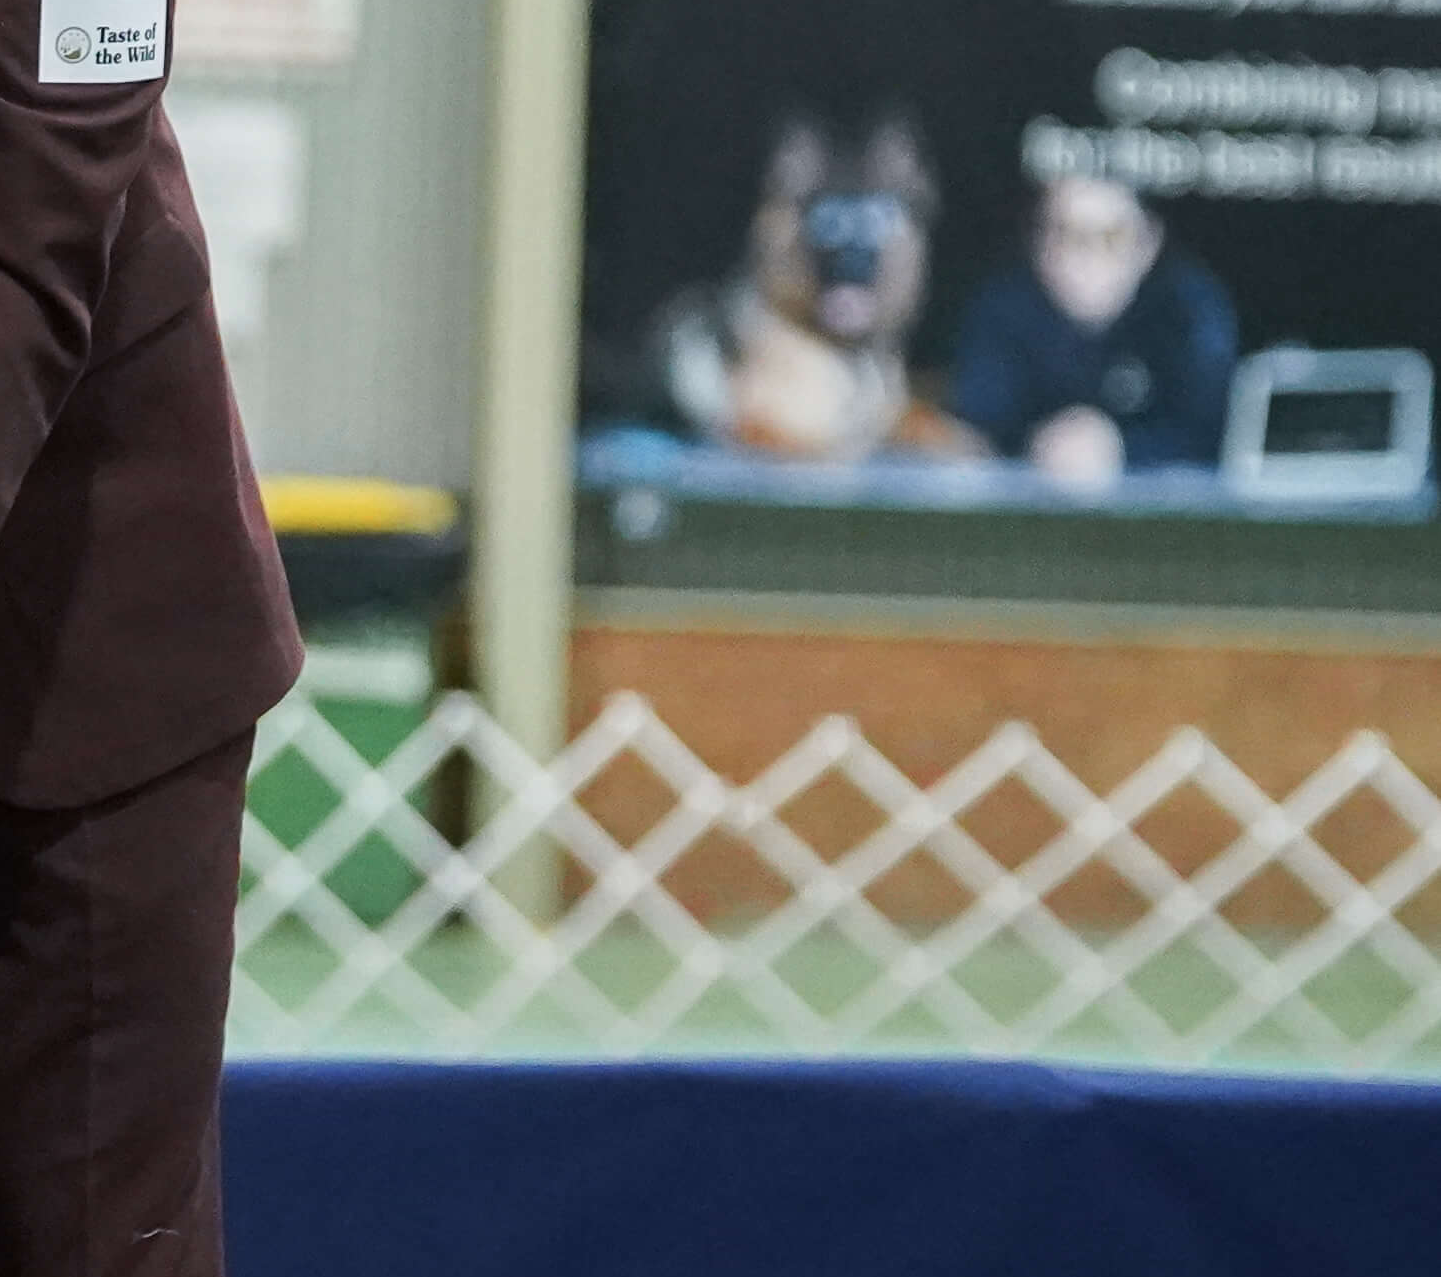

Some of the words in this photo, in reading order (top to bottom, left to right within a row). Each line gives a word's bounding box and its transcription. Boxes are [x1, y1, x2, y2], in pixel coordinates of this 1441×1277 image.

[96, 26, 141, 43] Taste
[144, 22, 157, 41] of
[95, 47, 122, 65] the
[128, 44, 156, 63] Wild
